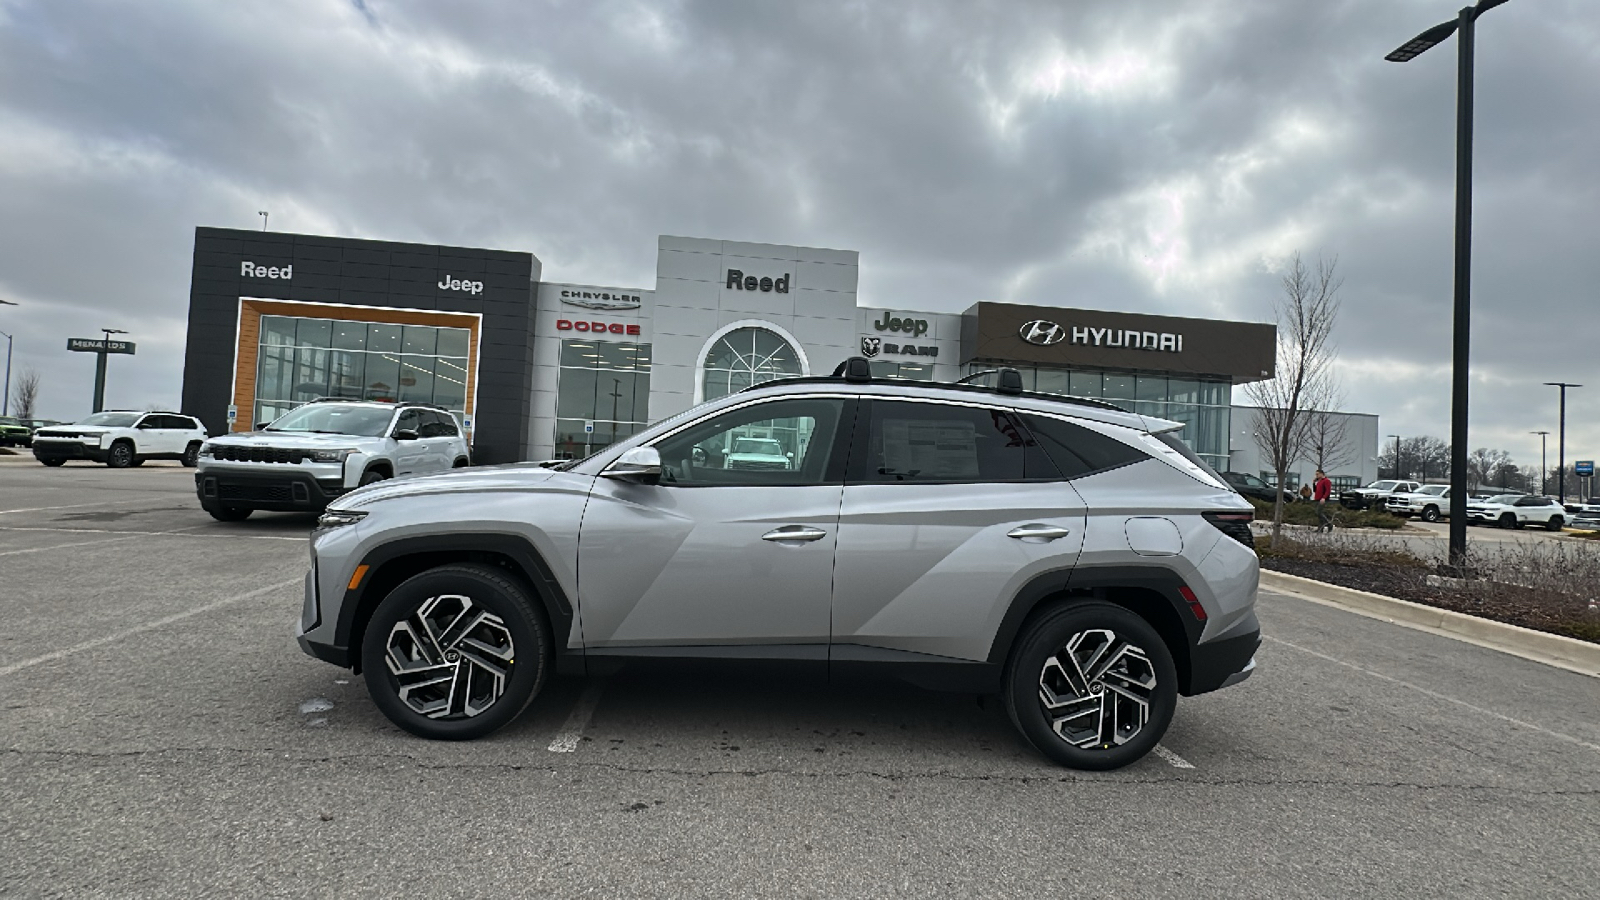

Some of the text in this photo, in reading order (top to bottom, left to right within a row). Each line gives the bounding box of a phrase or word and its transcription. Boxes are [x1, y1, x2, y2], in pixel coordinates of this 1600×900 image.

[240, 261, 293, 280] Reed
[437, 275, 484, 295] Jeep
[727, 268, 790, 294] Reed
[561, 290, 641, 303] CHRYSLER
[556, 319, 641, 336] DODGE
[874, 311, 929, 338] Jeep
[1071, 326, 1184, 353] HYUNDAI
[883, 343, 939, 358] RAM
